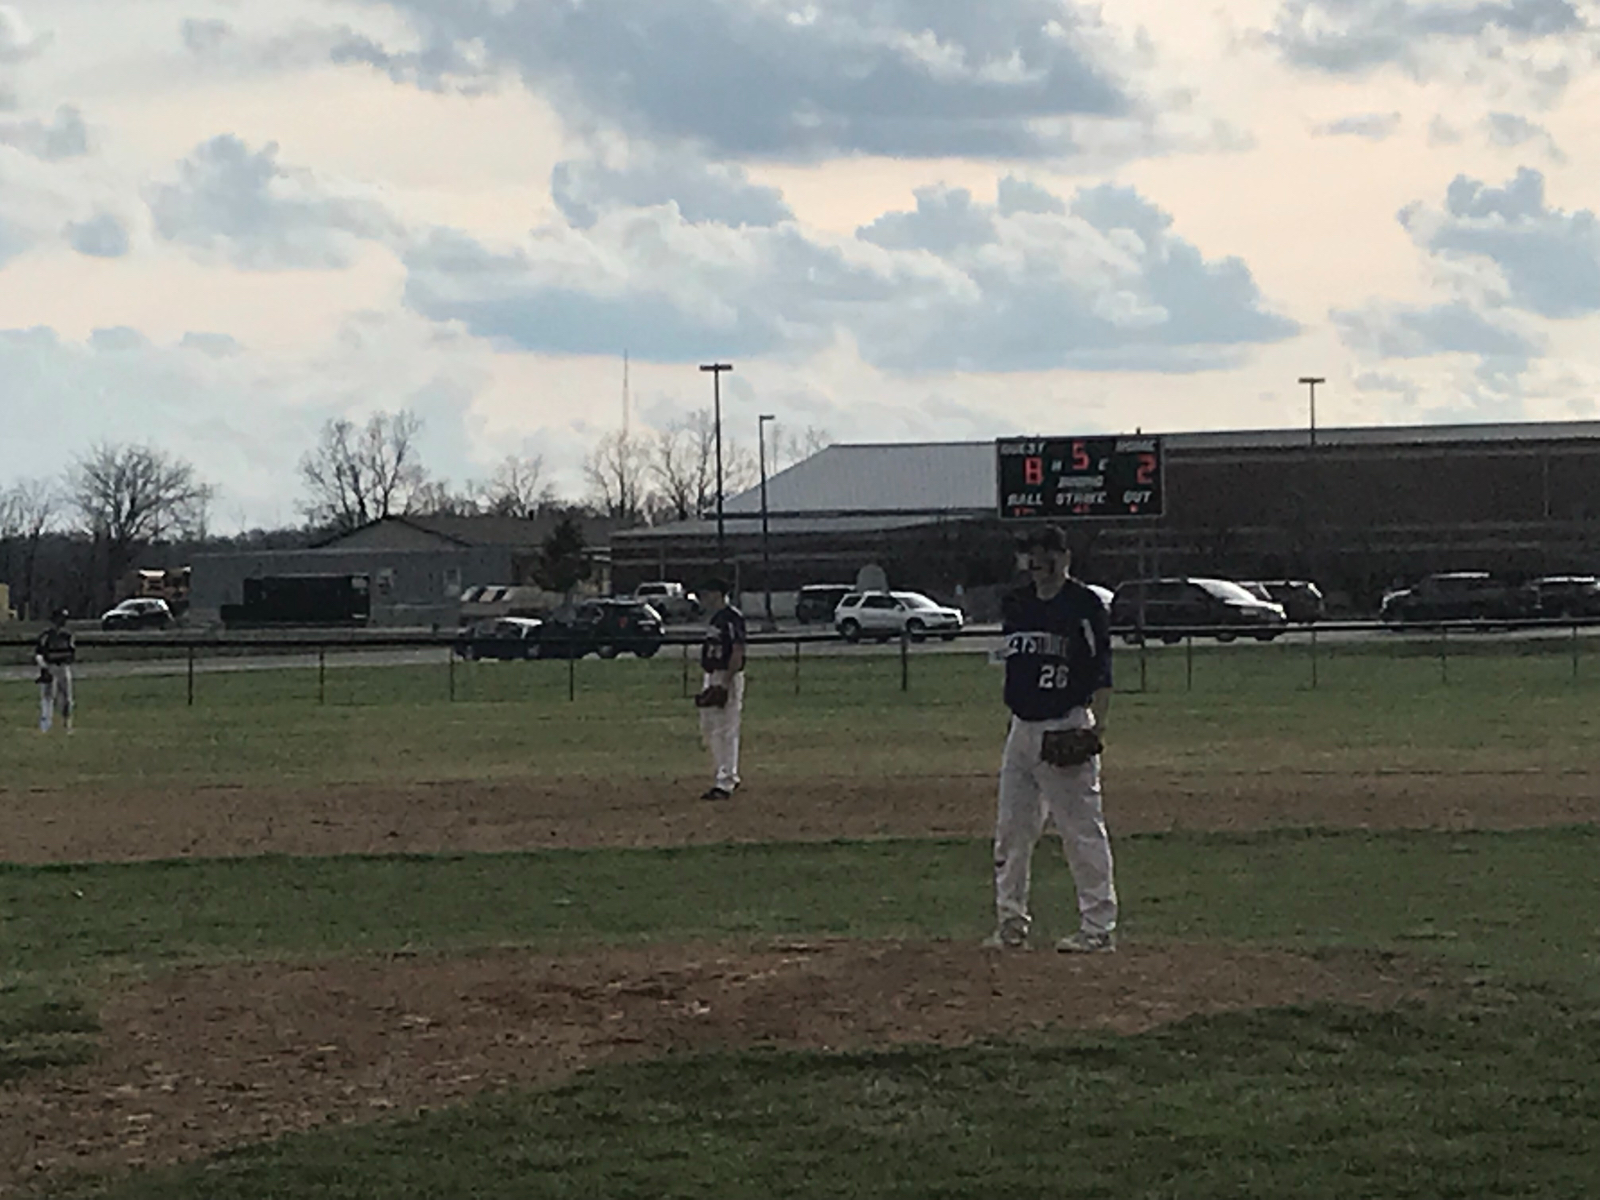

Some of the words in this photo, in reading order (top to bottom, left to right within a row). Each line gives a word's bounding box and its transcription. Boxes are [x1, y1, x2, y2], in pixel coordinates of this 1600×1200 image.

[1072, 440, 1090, 470] 5
[1024, 457, 1044, 485] 8
[1137, 454, 1156, 484] 2
[1007, 493, 1044, 506] BALL
[1056, 491, 1107, 505] STRIKE
[1123, 490, 1152, 503] OUT
[1039, 665, 1070, 688] 26
